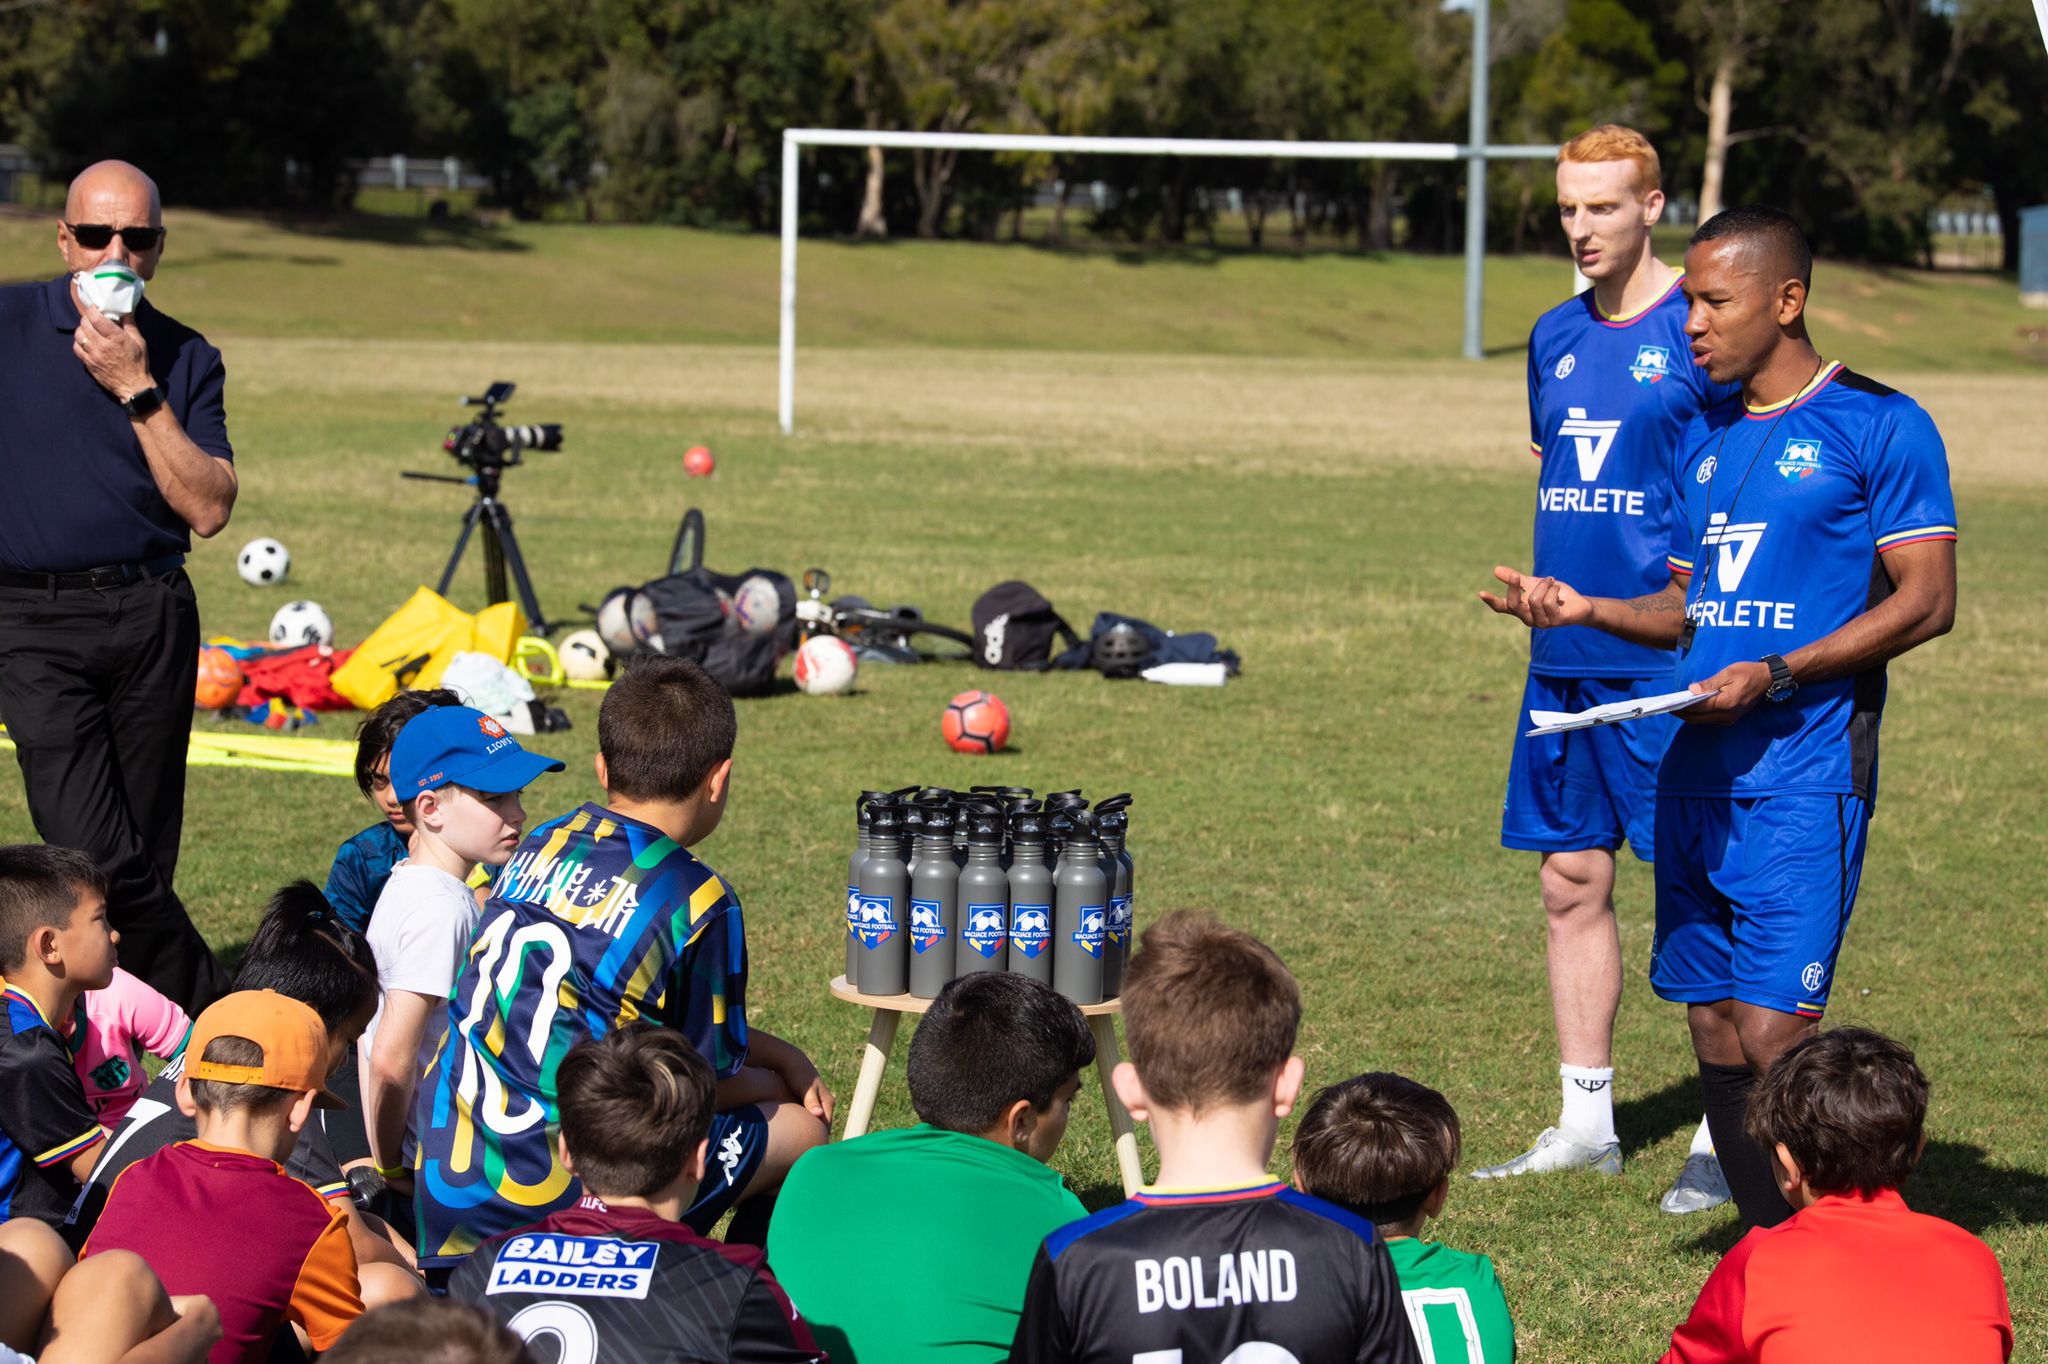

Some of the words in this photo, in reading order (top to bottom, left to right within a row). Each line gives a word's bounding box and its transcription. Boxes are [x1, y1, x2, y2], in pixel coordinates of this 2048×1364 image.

[1540, 488, 1645, 515] VERLETE
[458, 910, 572, 1134] 10
[64, 1097, 172, 1225] 7
[503, 1237, 650, 1267] BAILEY
[496, 1268, 638, 1291] LADDERS
[1134, 1249, 1297, 1313] BOLAND
